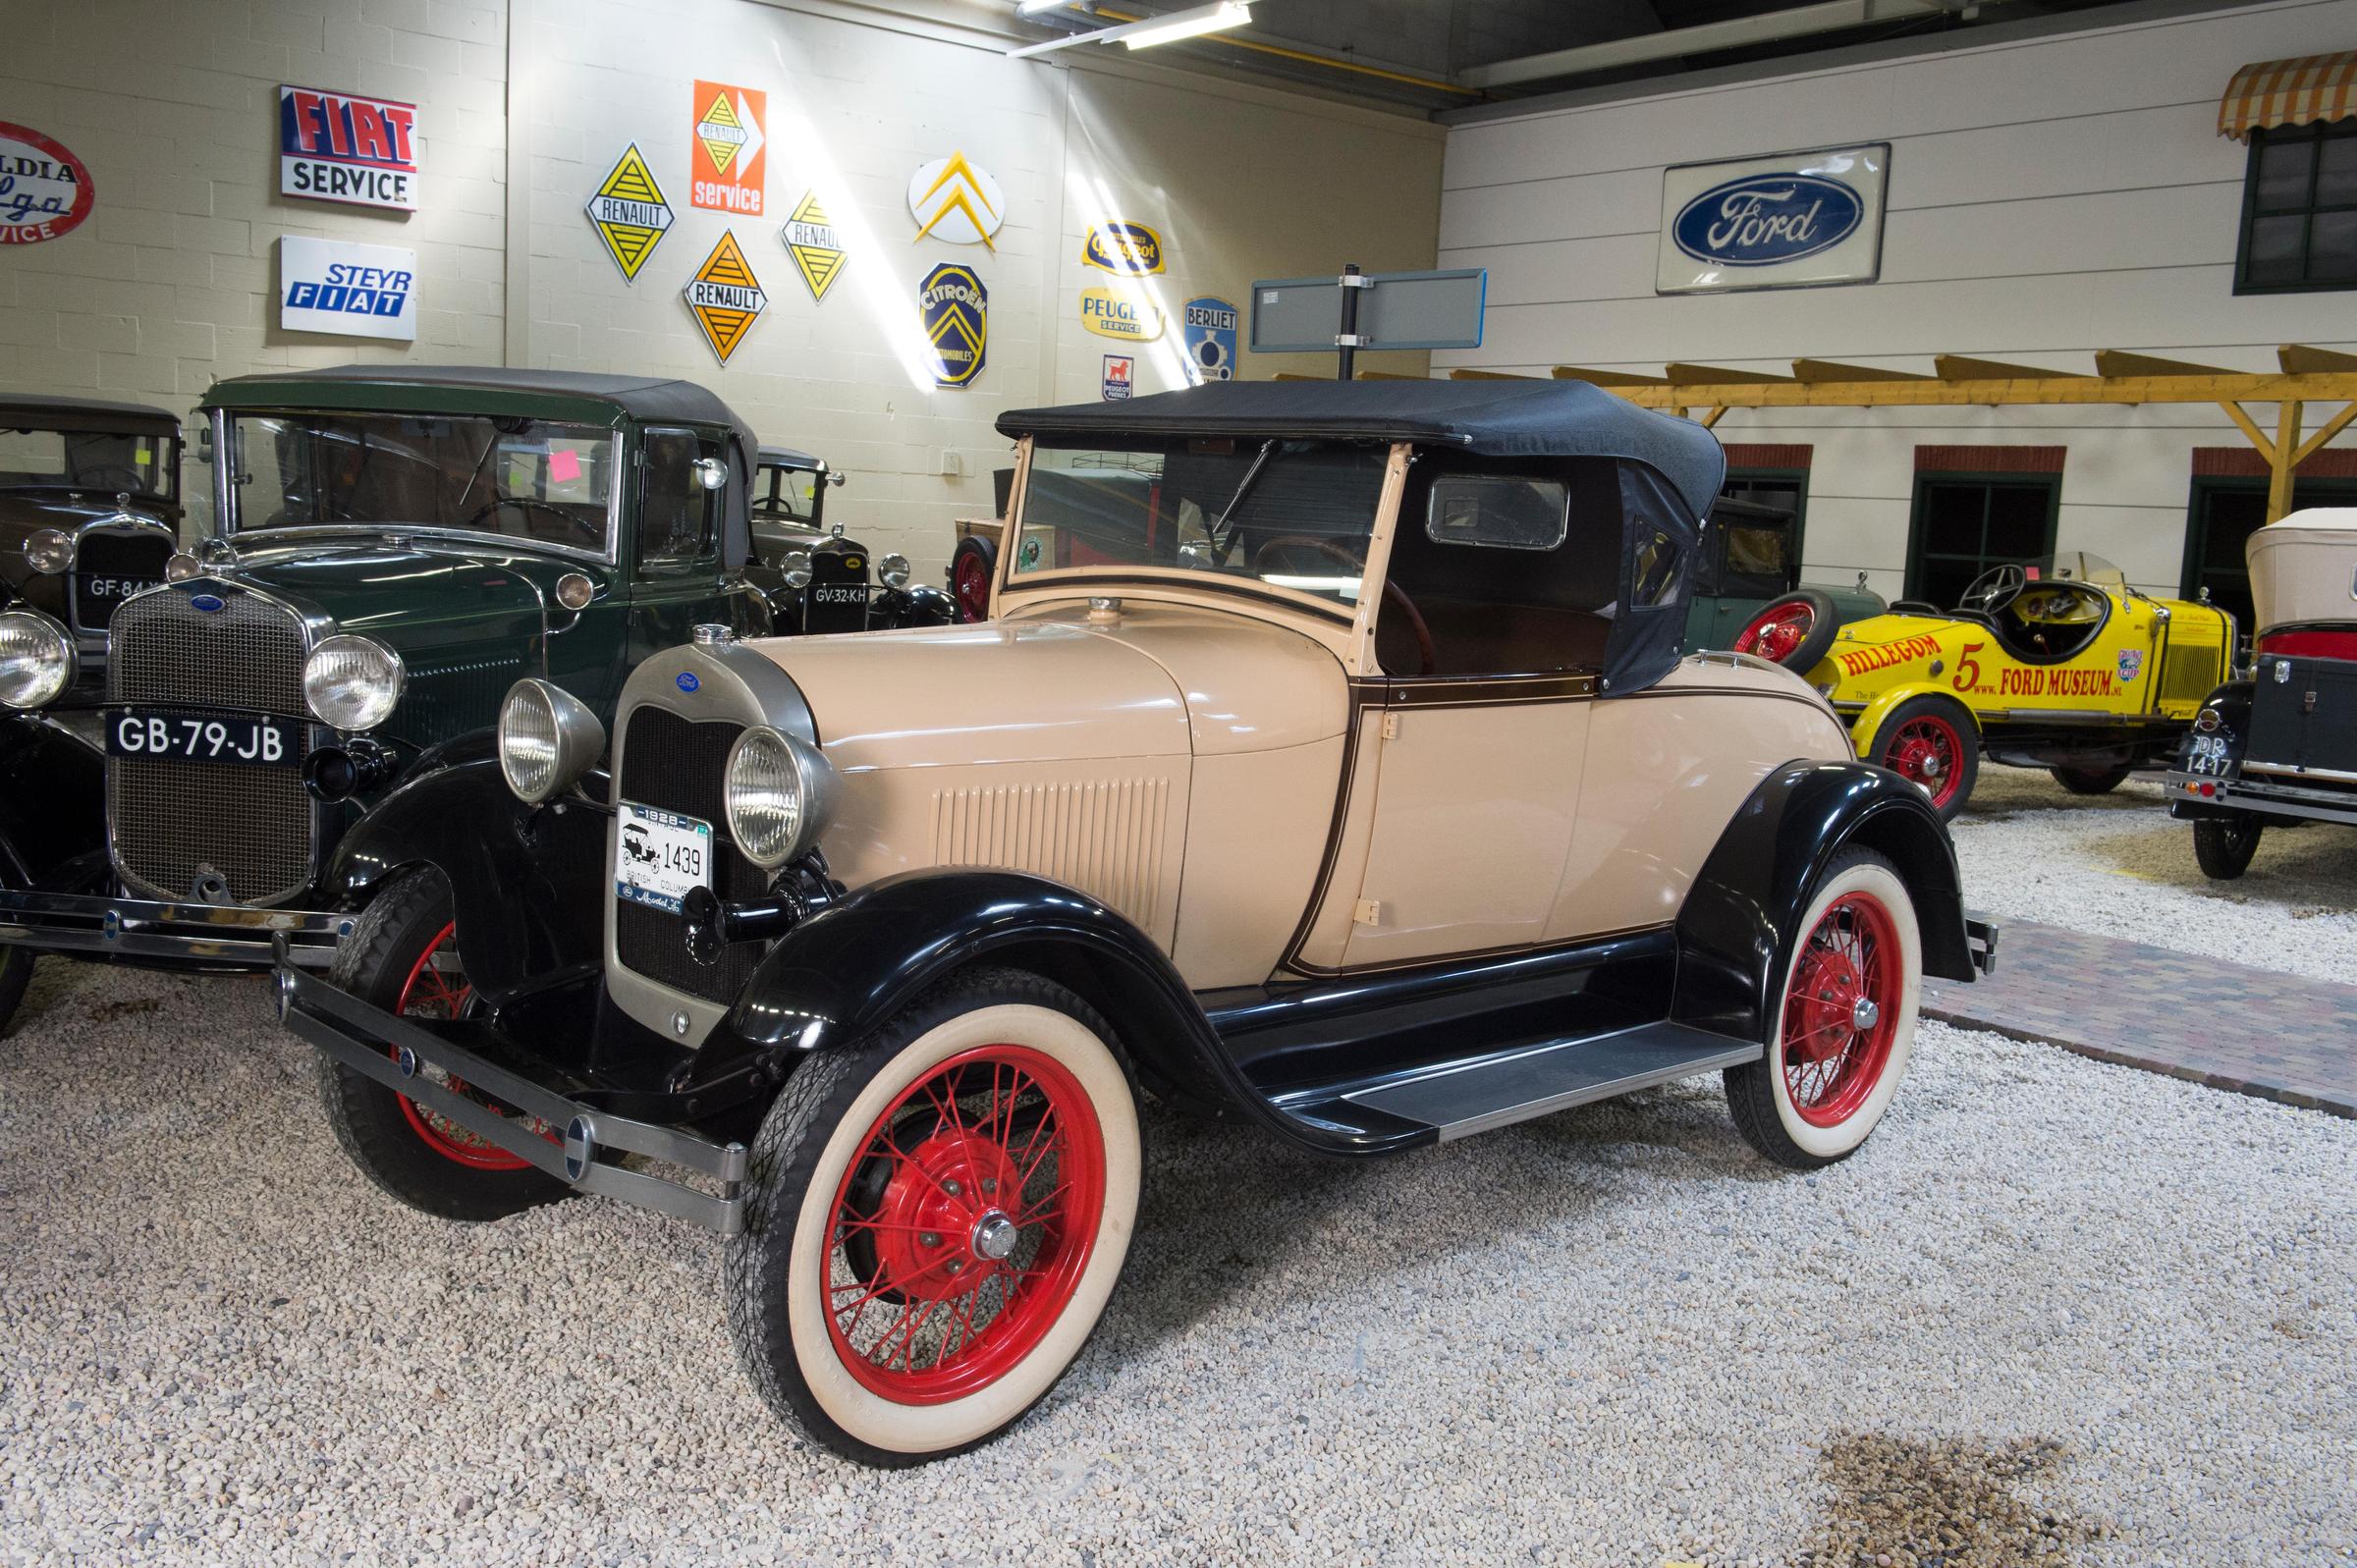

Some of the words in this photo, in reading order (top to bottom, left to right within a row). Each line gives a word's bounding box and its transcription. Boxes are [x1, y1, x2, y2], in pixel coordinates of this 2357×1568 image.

[292, 90, 413, 163] FIAT
[704, 124, 741, 142] RENAULT
[294, 162, 408, 202] SERVICE
[694, 181, 761, 212] service
[602, 199, 662, 227] RENAULT
[1707, 188, 1824, 250] Ford
[795, 224, 844, 249] RENAUL
[325, 263, 412, 292] STEYR
[293, 285, 401, 314] FIAT
[695, 283, 760, 310] RENAULT
[1083, 297, 1161, 323] PEUGET
[1101, 320, 1140, 333] SERVICE
[1187, 307, 1235, 330] BERLIET
[1104, 385, 1131, 395] PEUGEOT
[1838, 634, 1943, 676] HILLEGOM
[1952, 642, 1985, 693] 5
[1999, 669, 2045, 696] FORD
[118, 717, 284, 762] GB-79-JB
[2199, 735, 2225, 756] DR
[2186, 755, 2233, 777] 14-17
[664, 842, 701, 877] 1439
[626, 870, 652, 885] BRITISH
[660, 880, 690, 895] COLUMB
[635, 891, 668, 908] Model
